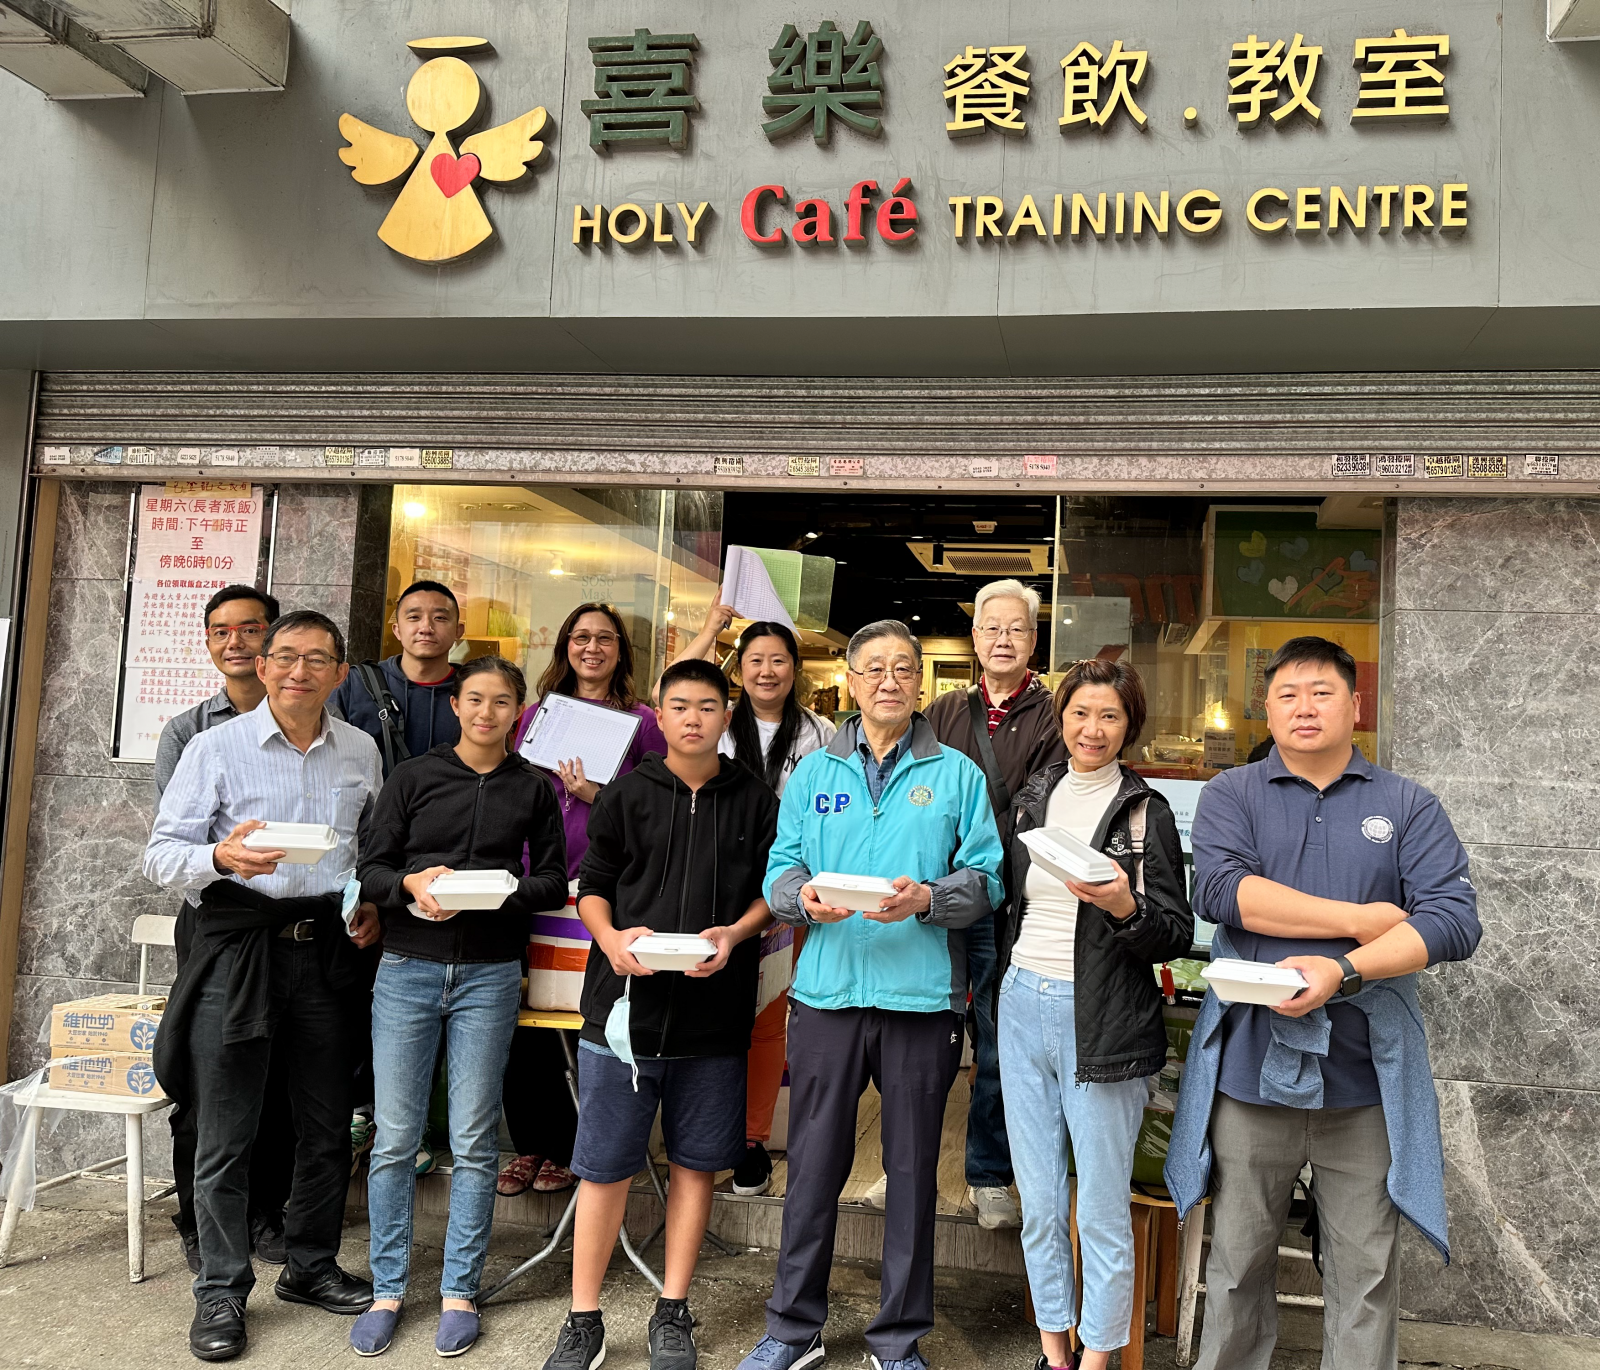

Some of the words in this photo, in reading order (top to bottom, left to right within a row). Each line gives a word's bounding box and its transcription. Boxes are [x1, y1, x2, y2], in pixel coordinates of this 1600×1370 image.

[580, 20, 885, 153] 喜樂
[572, 201, 711, 249] HOLY
[741, 177, 919, 249] Café
[949, 189, 1222, 242] TRAINING
[1246, 183, 1469, 239] CENTRE
[1430, 465, 1443, 476] 6579
[191, 536, 204, 550] 至
[581, 588, 613, 600] Mask
[814, 792, 851, 815] CP
[63, 1012, 115, 1030] 維他奶
